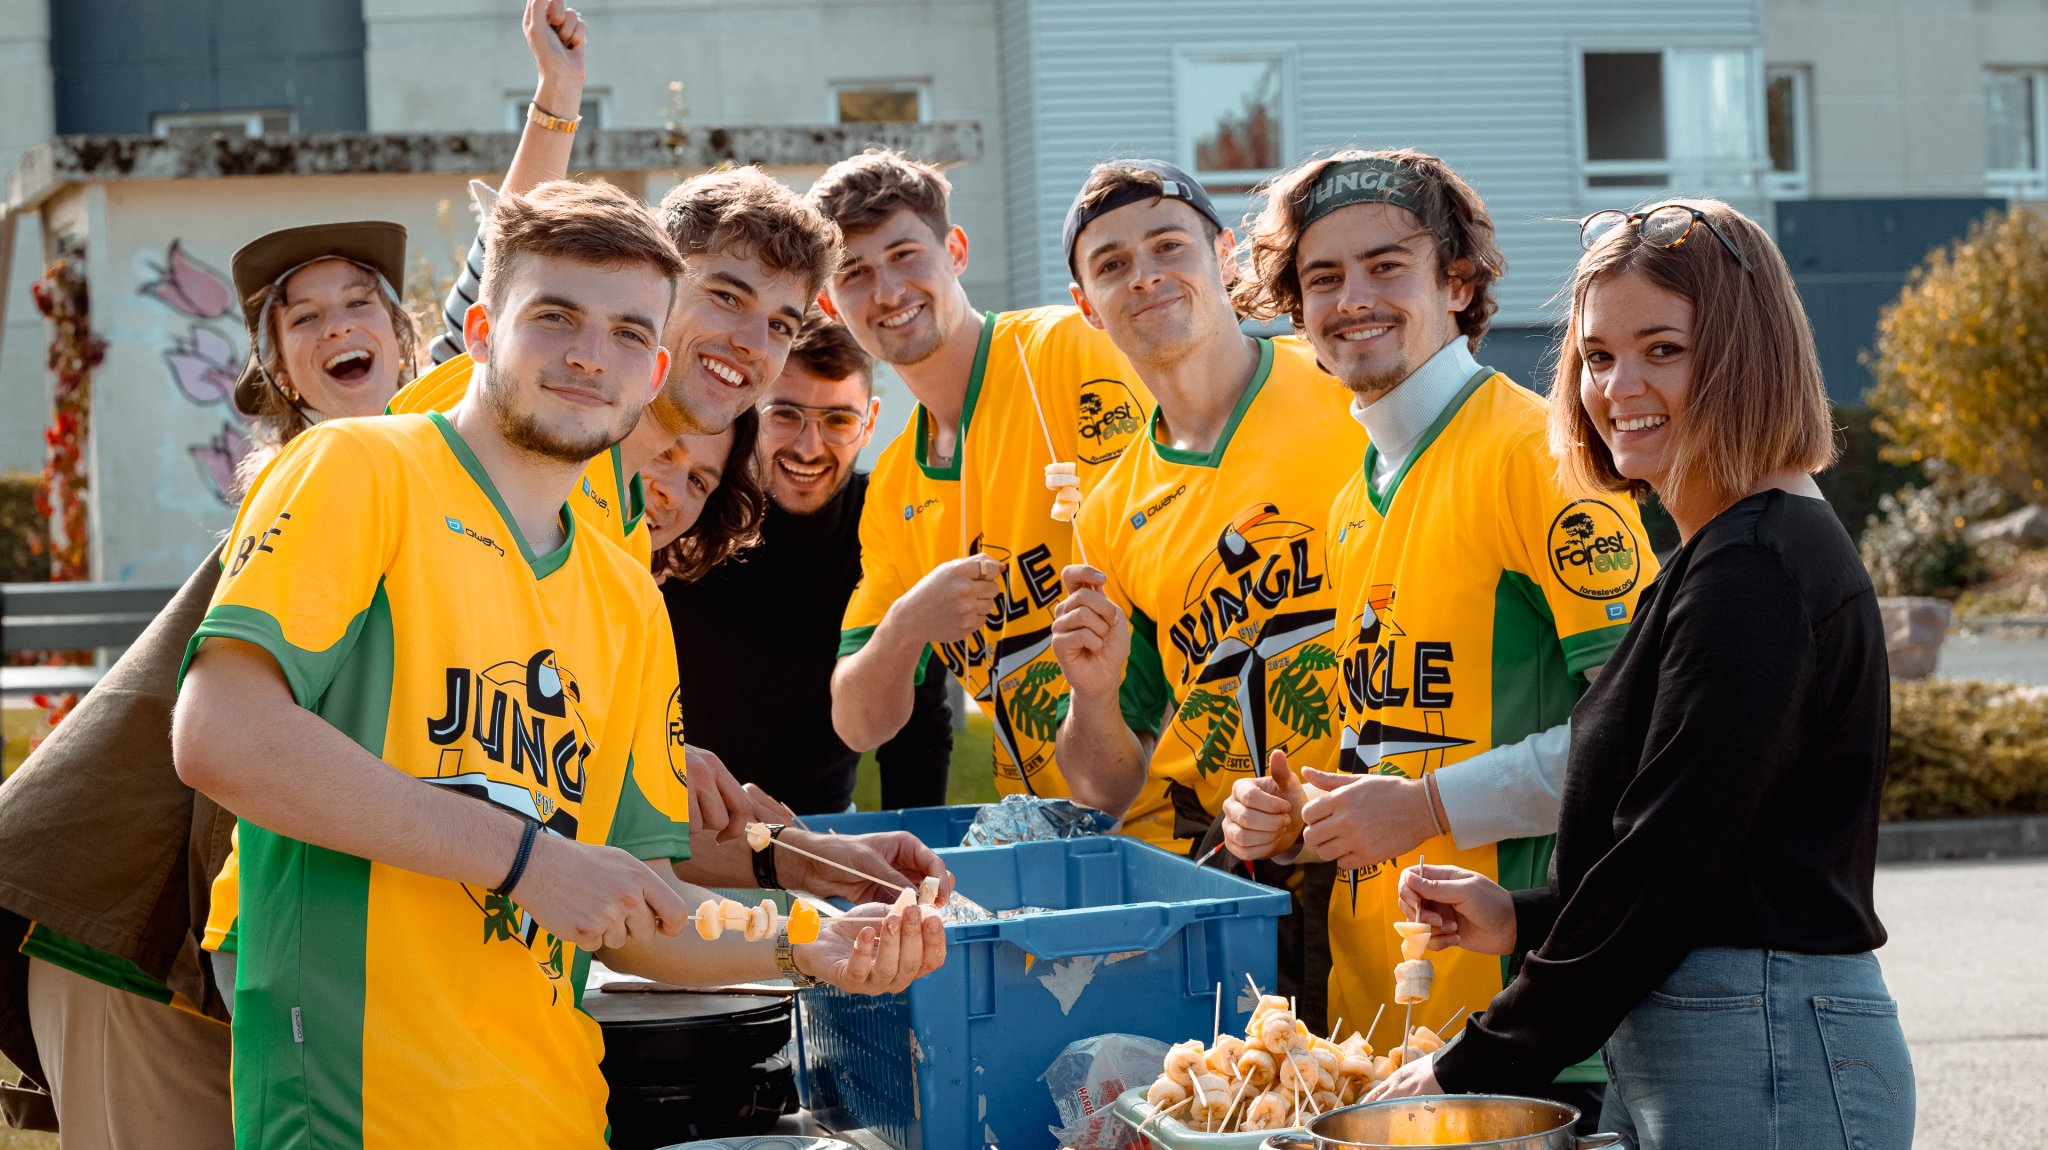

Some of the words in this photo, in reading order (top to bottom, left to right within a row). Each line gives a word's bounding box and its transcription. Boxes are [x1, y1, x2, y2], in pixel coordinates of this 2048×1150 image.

[1079, 401, 1132, 438] orest
[1555, 531, 1626, 572] Forest
[1594, 548, 1633, 573] ever
[1579, 579, 1632, 596] forestever.org
[1226, 757, 1250, 769] ESITC
